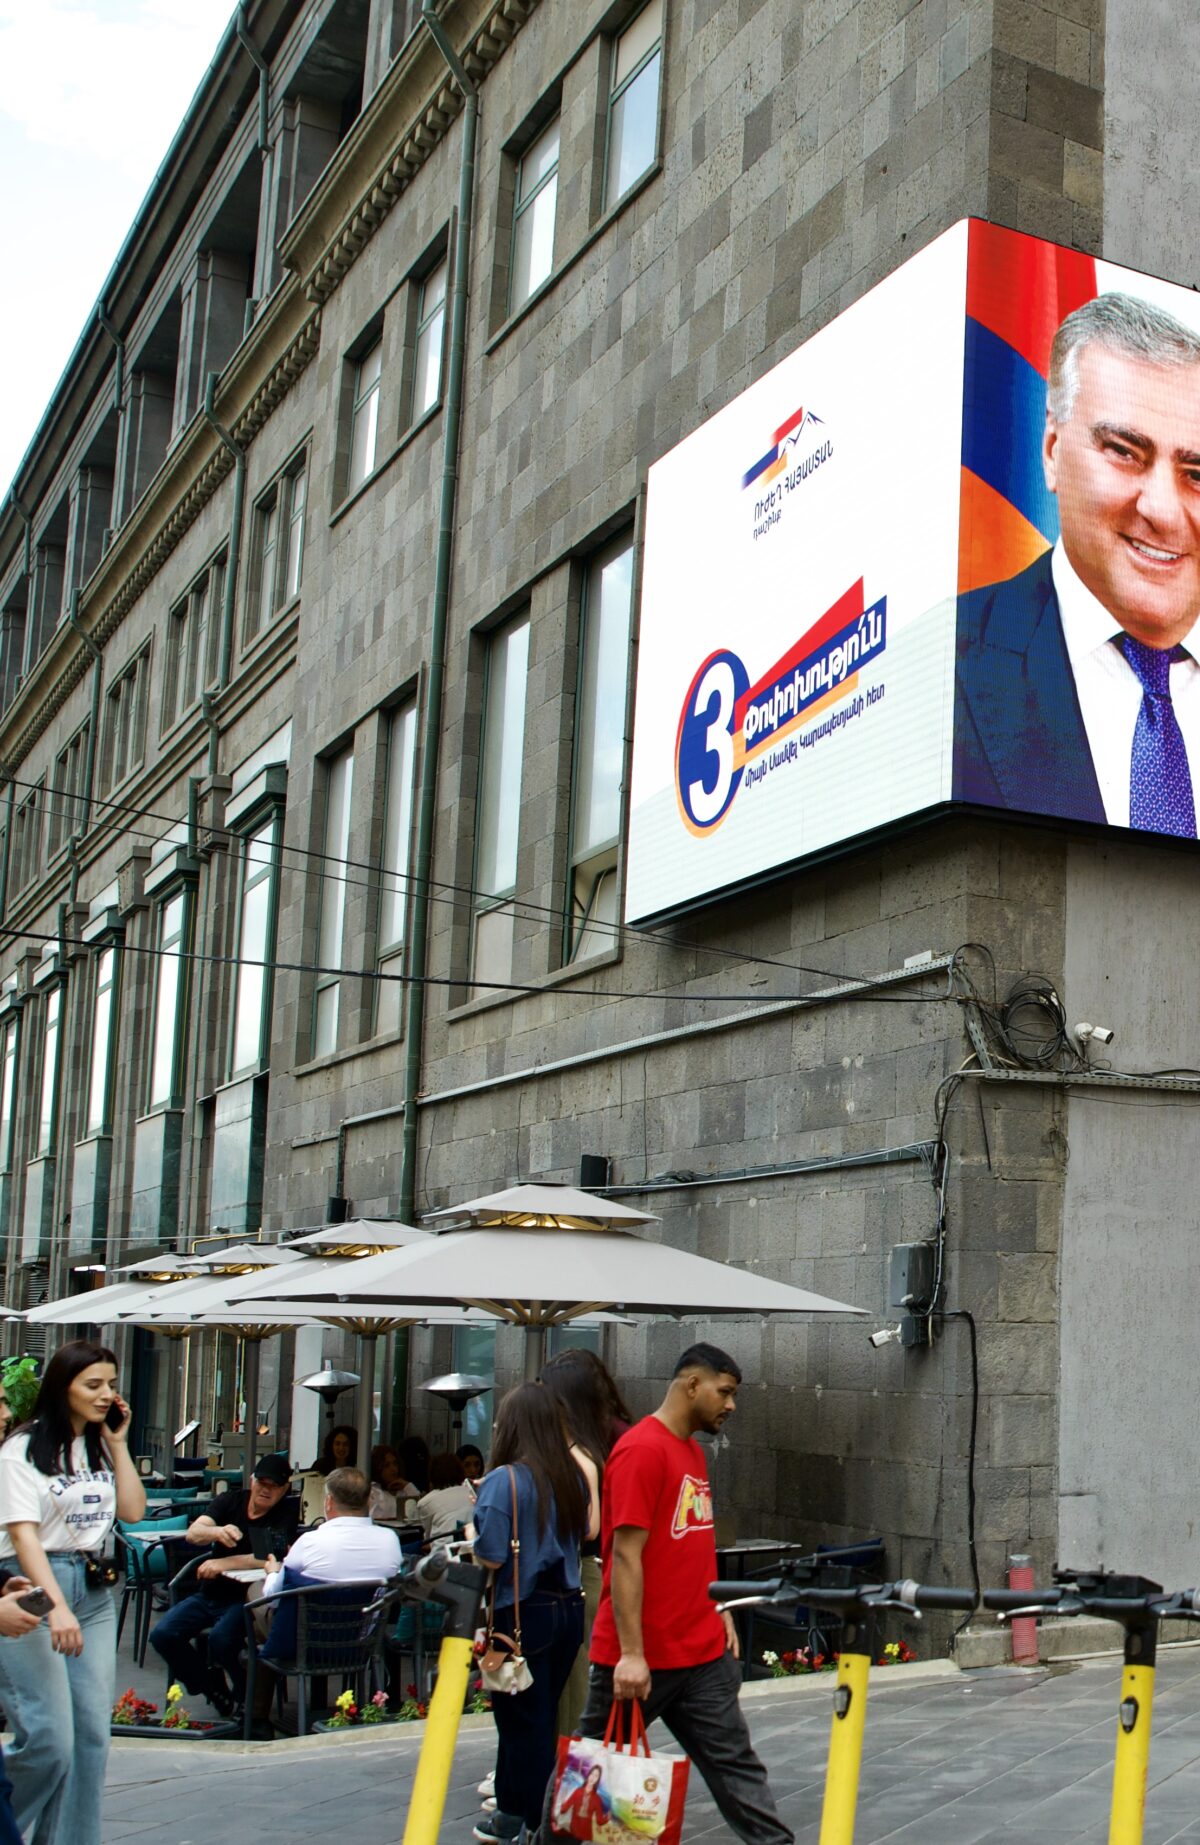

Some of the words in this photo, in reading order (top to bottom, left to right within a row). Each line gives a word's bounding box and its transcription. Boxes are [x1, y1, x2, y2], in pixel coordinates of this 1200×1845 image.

[754, 484, 782, 522] ՈՒԺԵՂ
[784, 440, 834, 494] ՀԱՅԱՍՏԱՆ
[689, 661, 735, 824] 3
[745, 760, 768, 789] միայն
[769, 741, 798, 770] Սամվել
[799, 703, 864, 749] Կարապետյանի
[866, 683, 886, 708] հետ
